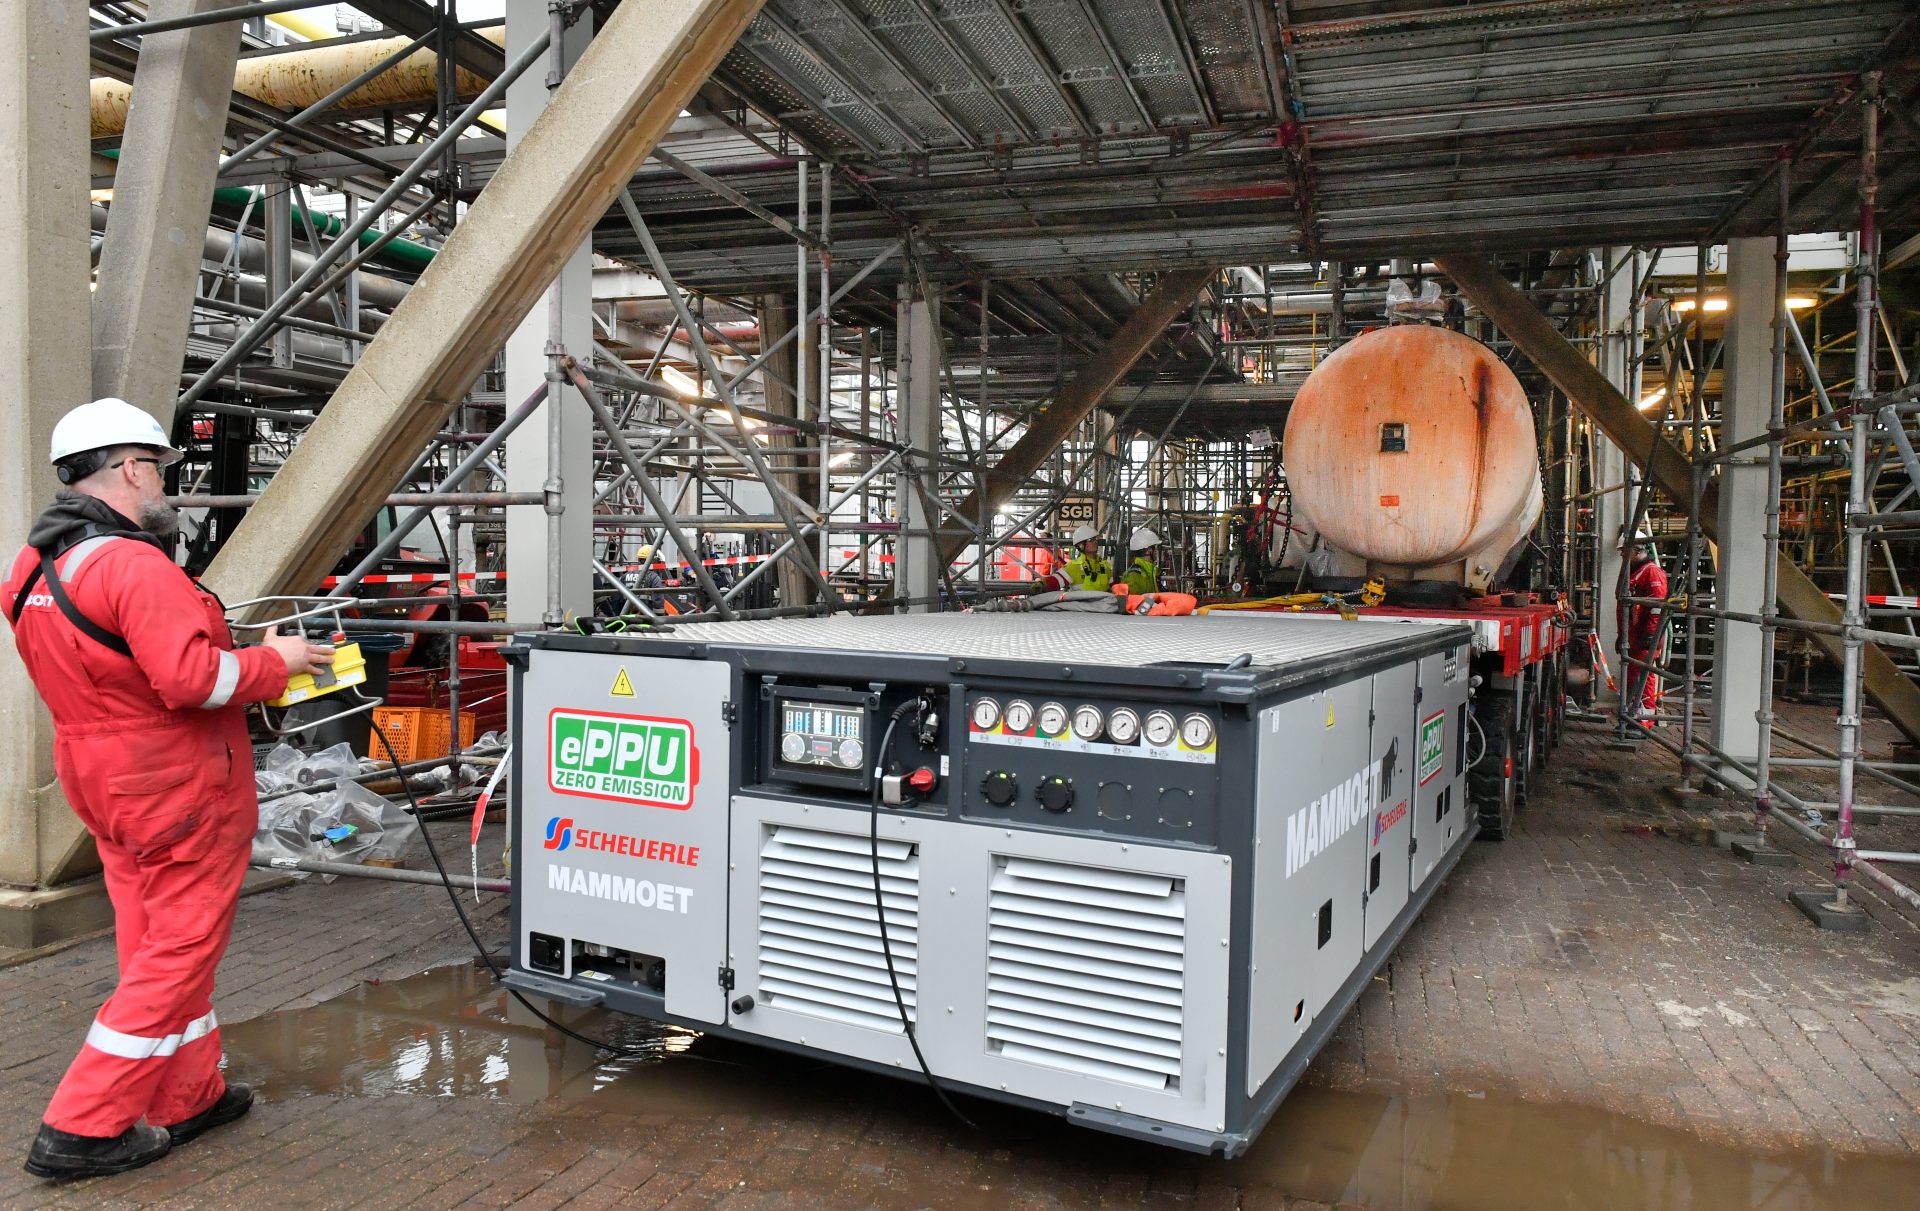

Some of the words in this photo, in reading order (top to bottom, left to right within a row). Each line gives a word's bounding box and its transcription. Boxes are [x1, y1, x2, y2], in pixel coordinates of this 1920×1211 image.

[1061, 505, 1093, 518] SGB
[560, 728, 680, 776] ePPU
[1423, 722, 1443, 761] ePPU
[555, 770, 596, 789] ZERO
[601, 777, 685, 801] EMISSION
[1286, 760, 1381, 880] MAMMOET
[575, 828, 700, 867] SCHEUERLE
[548, 864, 694, 914] MAMMOET
